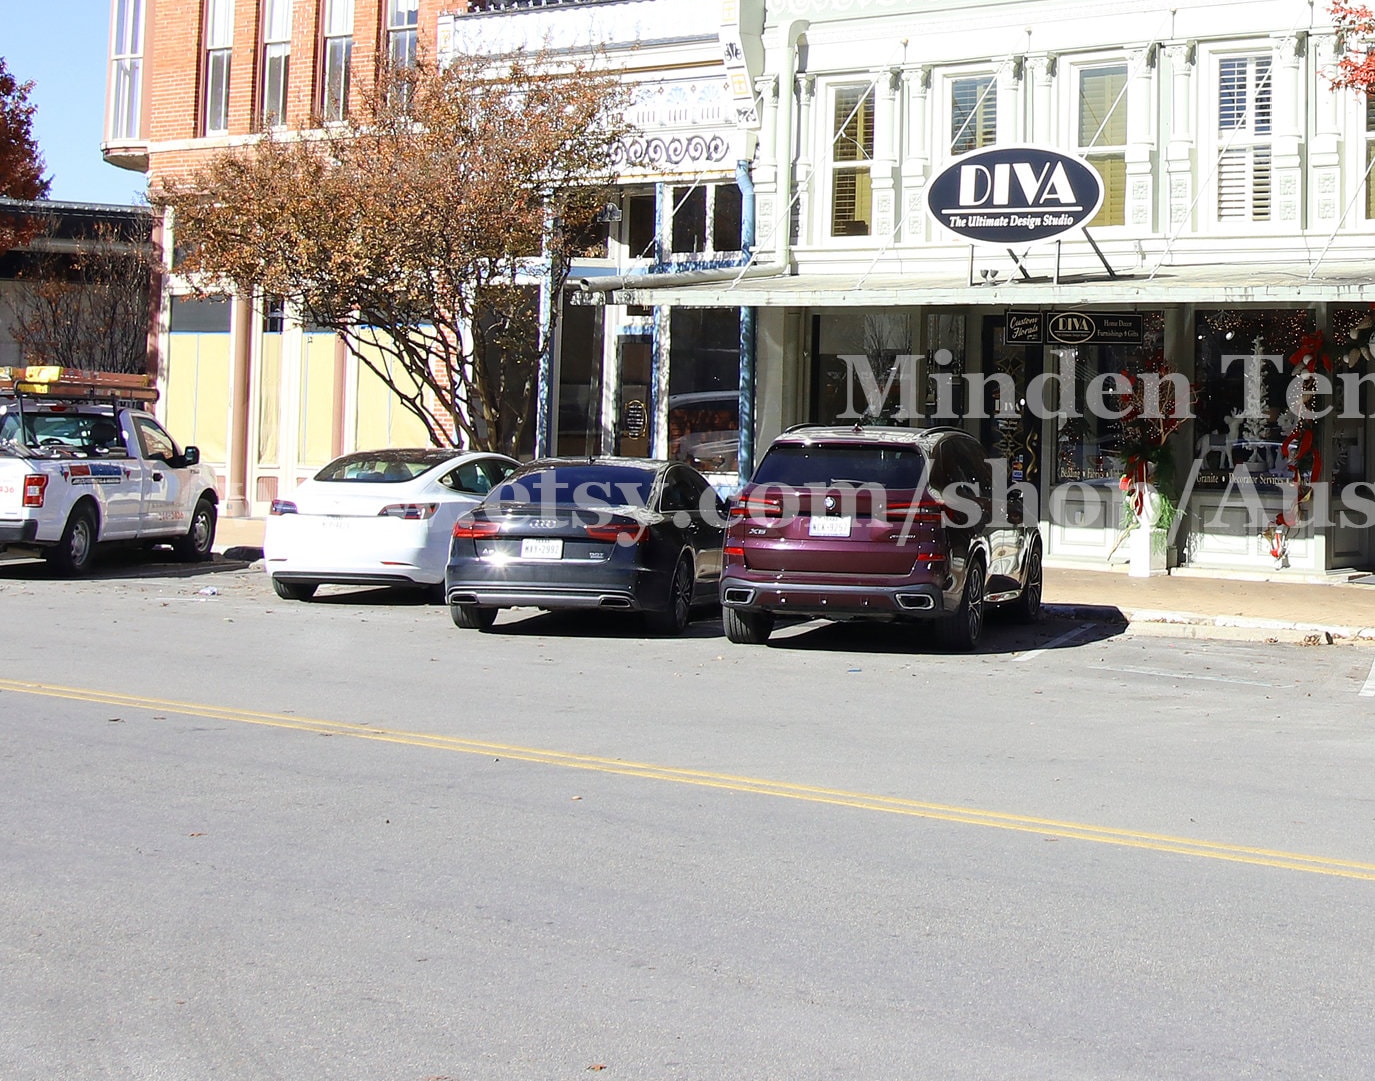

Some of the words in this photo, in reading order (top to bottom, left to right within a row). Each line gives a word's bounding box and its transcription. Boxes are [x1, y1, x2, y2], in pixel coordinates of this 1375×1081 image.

[958, 160, 1077, 206] DIVA
[949, 215, 966, 228] The
[968, 214, 1009, 227] Ultimate
[1010, 214, 1042, 230] Design
[1043, 213, 1074, 227] Studio
[1010, 316, 1038, 329] Custom
[1058, 317, 1088, 331] DIVA
[1012, 324, 1039, 340] Florals
[1196, 472, 1219, 484] Granite
[1228, 472, 1258, 484] Decorator
[1259, 473, 1284, 485] Services
